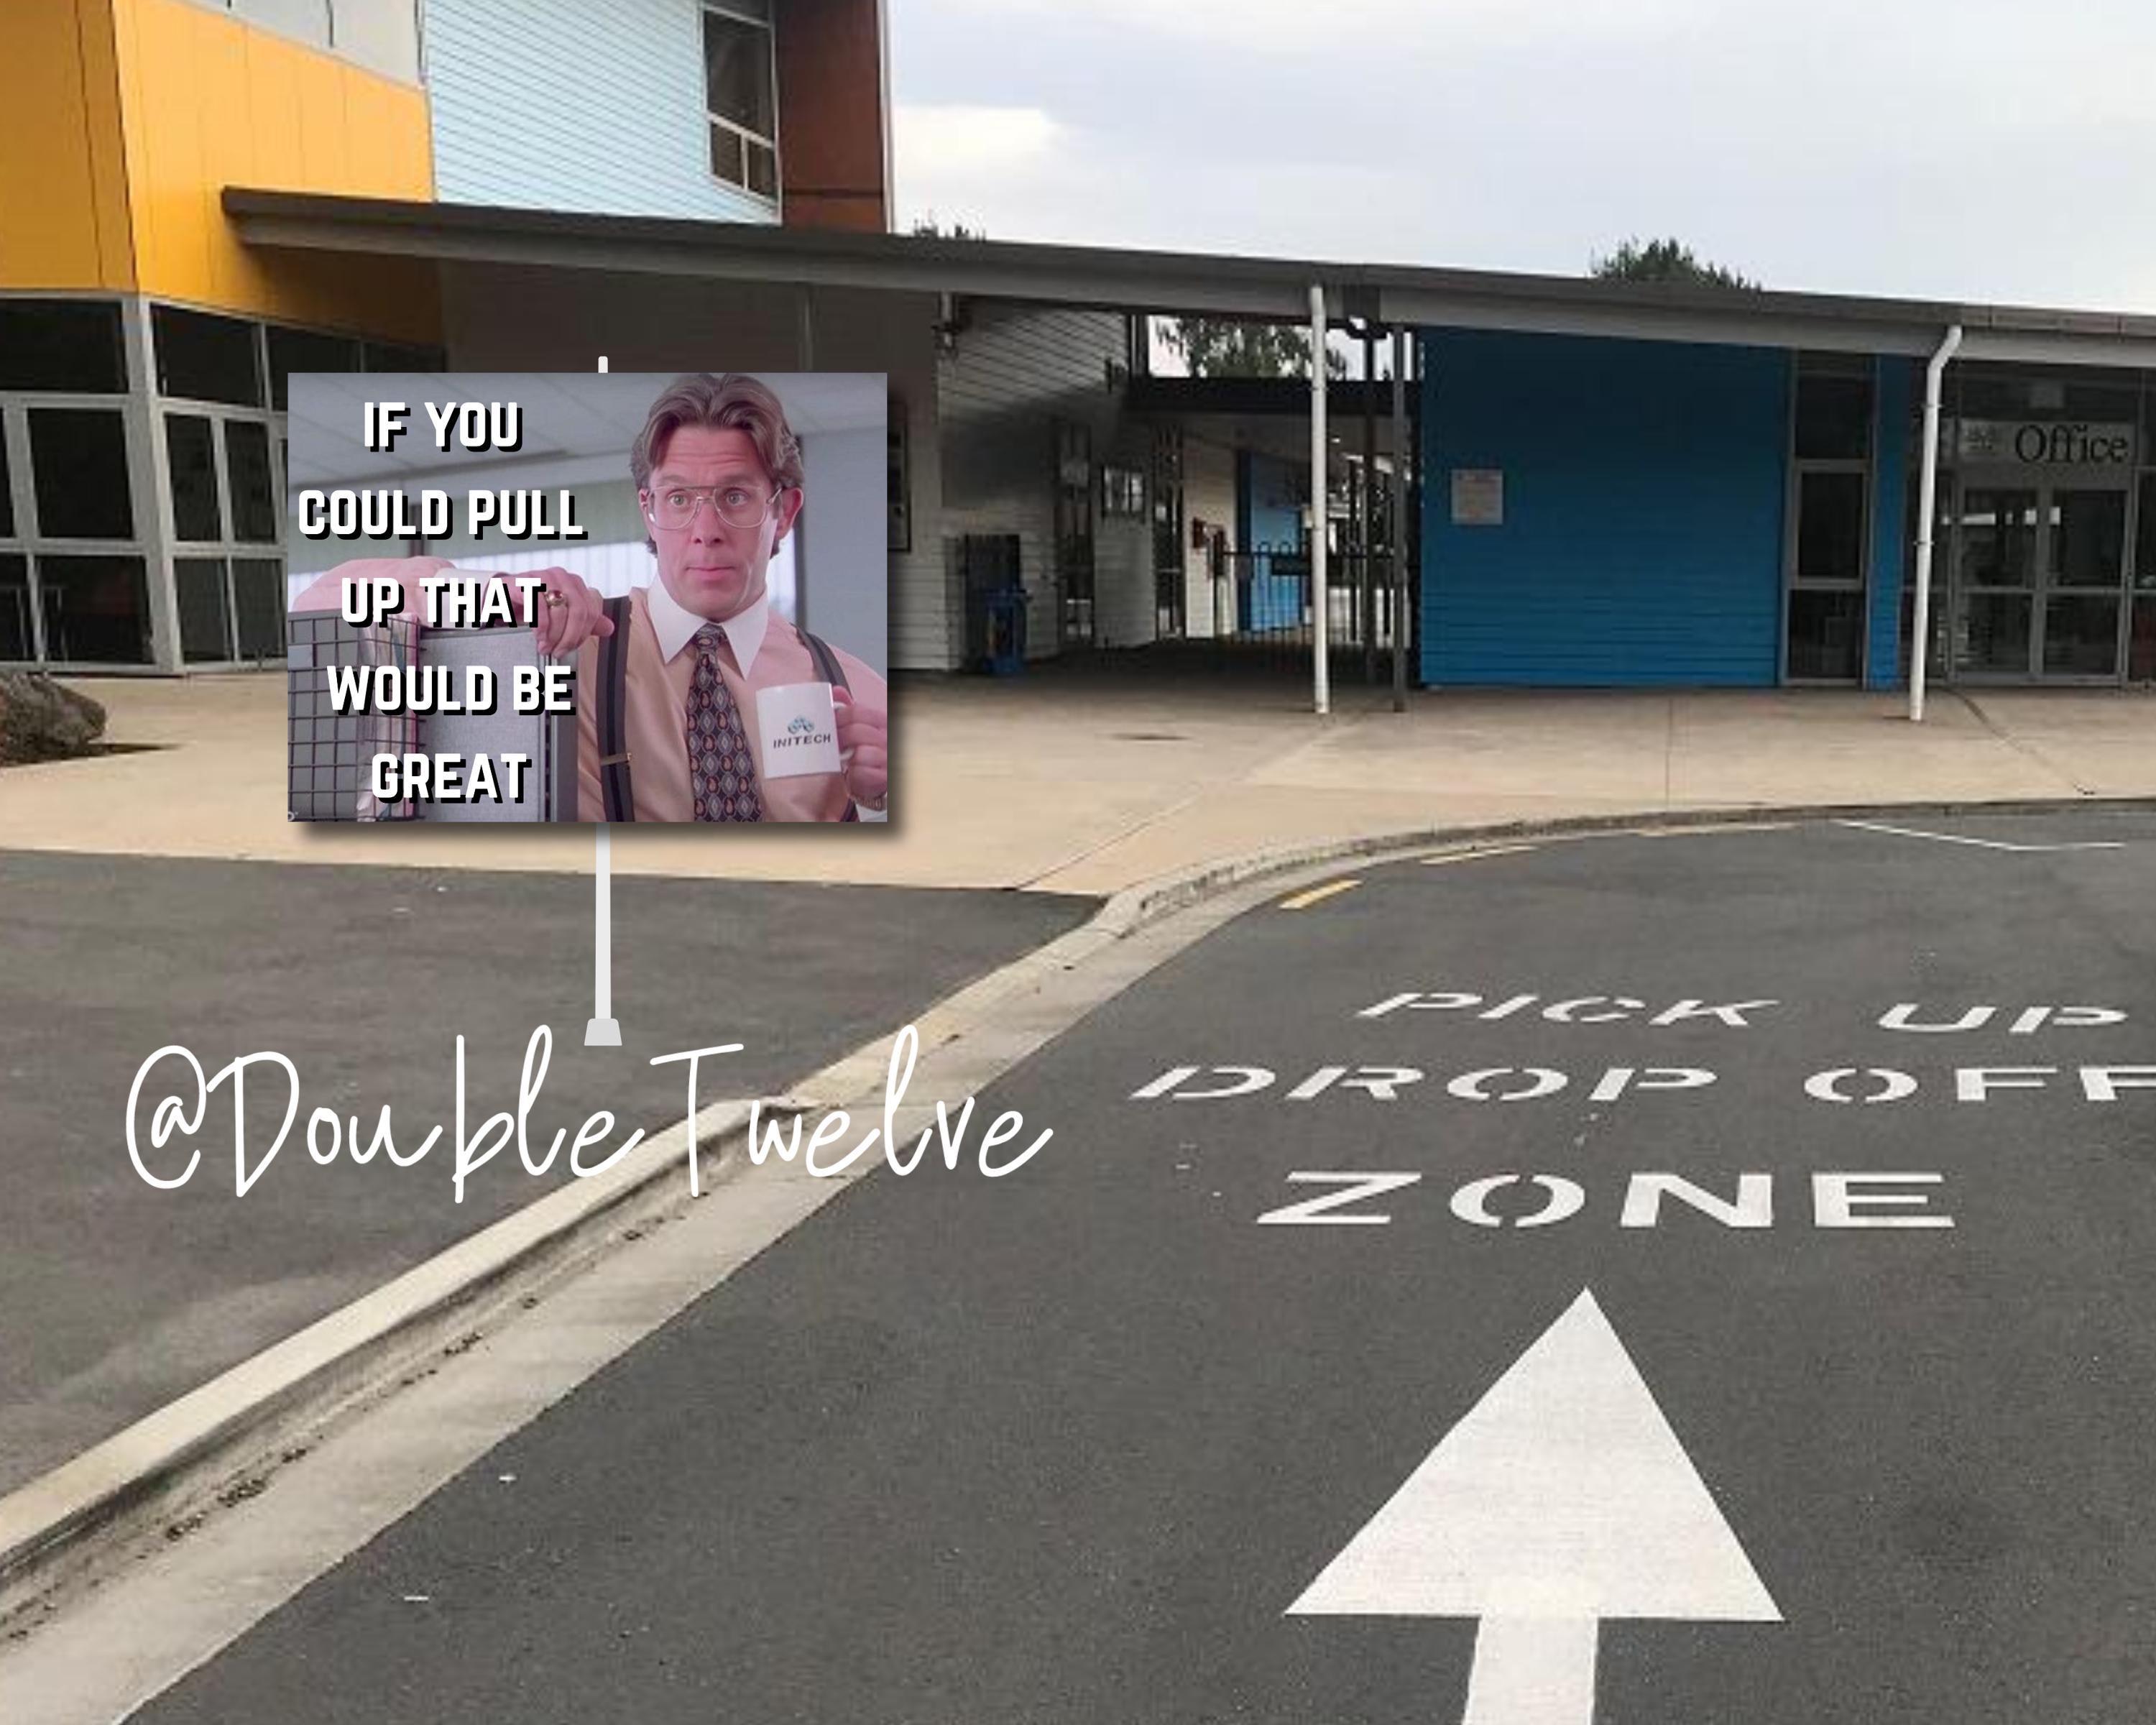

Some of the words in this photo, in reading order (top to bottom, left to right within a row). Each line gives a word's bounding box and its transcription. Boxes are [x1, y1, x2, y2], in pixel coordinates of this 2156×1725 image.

[2014, 424, 2129, 464] Office
[773, 733, 831, 749] INITECH
[1355, 992, 1779, 1027] PICK
[1877, 1003, 2129, 1034] UP
[1130, 1065, 1718, 1102] DROP
[1803, 1065, 2156, 1104] OFF
[1256, 1170, 1956, 1228] ZONE
